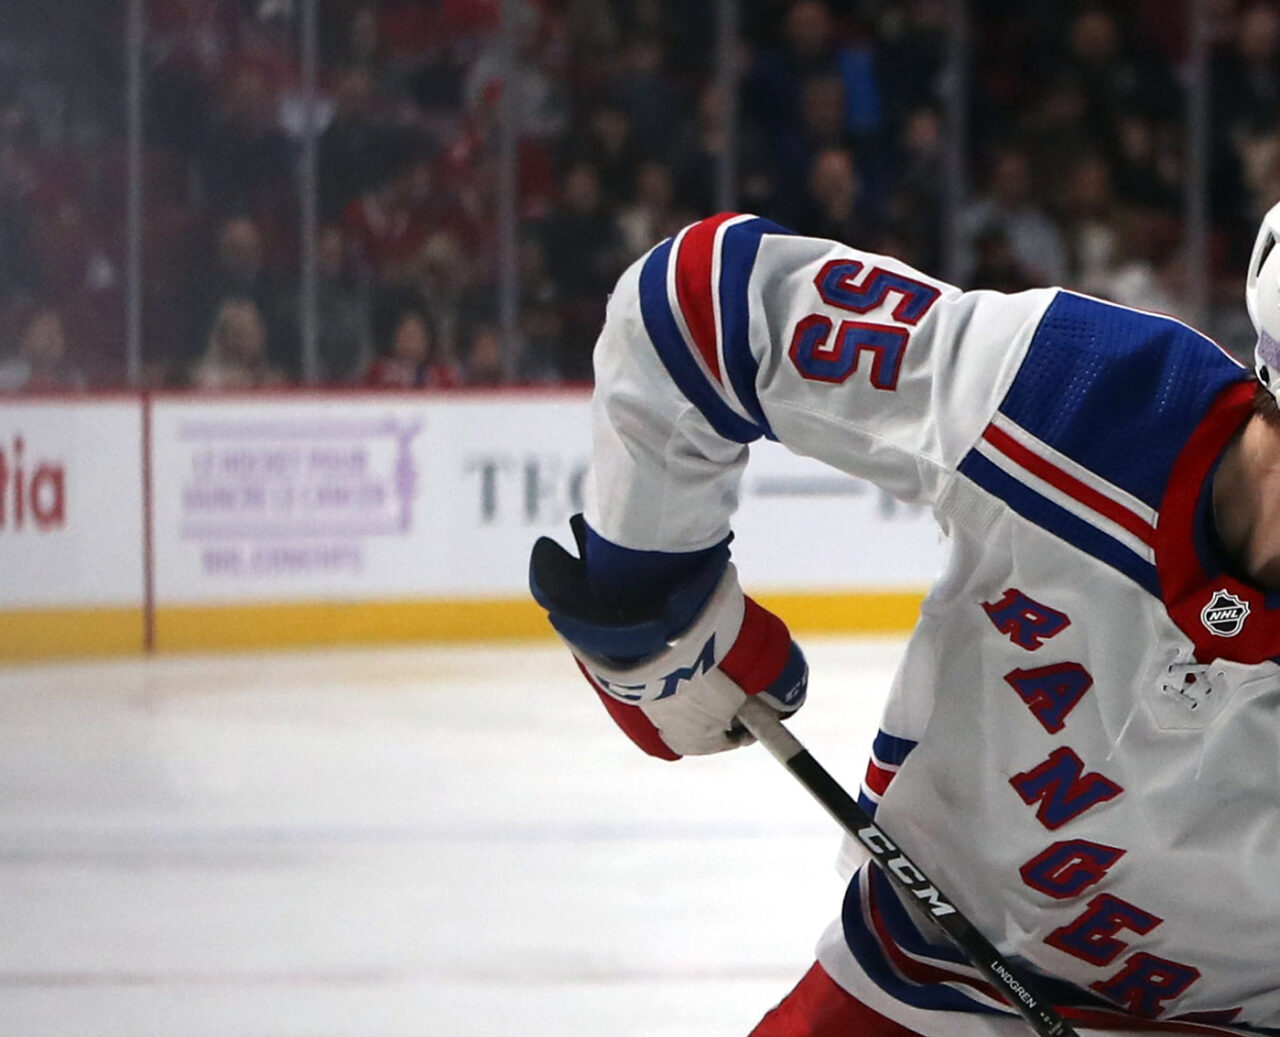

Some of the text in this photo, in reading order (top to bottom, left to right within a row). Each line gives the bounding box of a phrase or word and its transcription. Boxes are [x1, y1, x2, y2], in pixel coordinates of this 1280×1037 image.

[788, 259, 942, 391] 55
[1209, 609, 1239, 621] NHL
[981, 587, 1243, 1025] RANGER
[858, 823, 957, 917] CCM
[989, 960, 1038, 1009] LINDGREN
